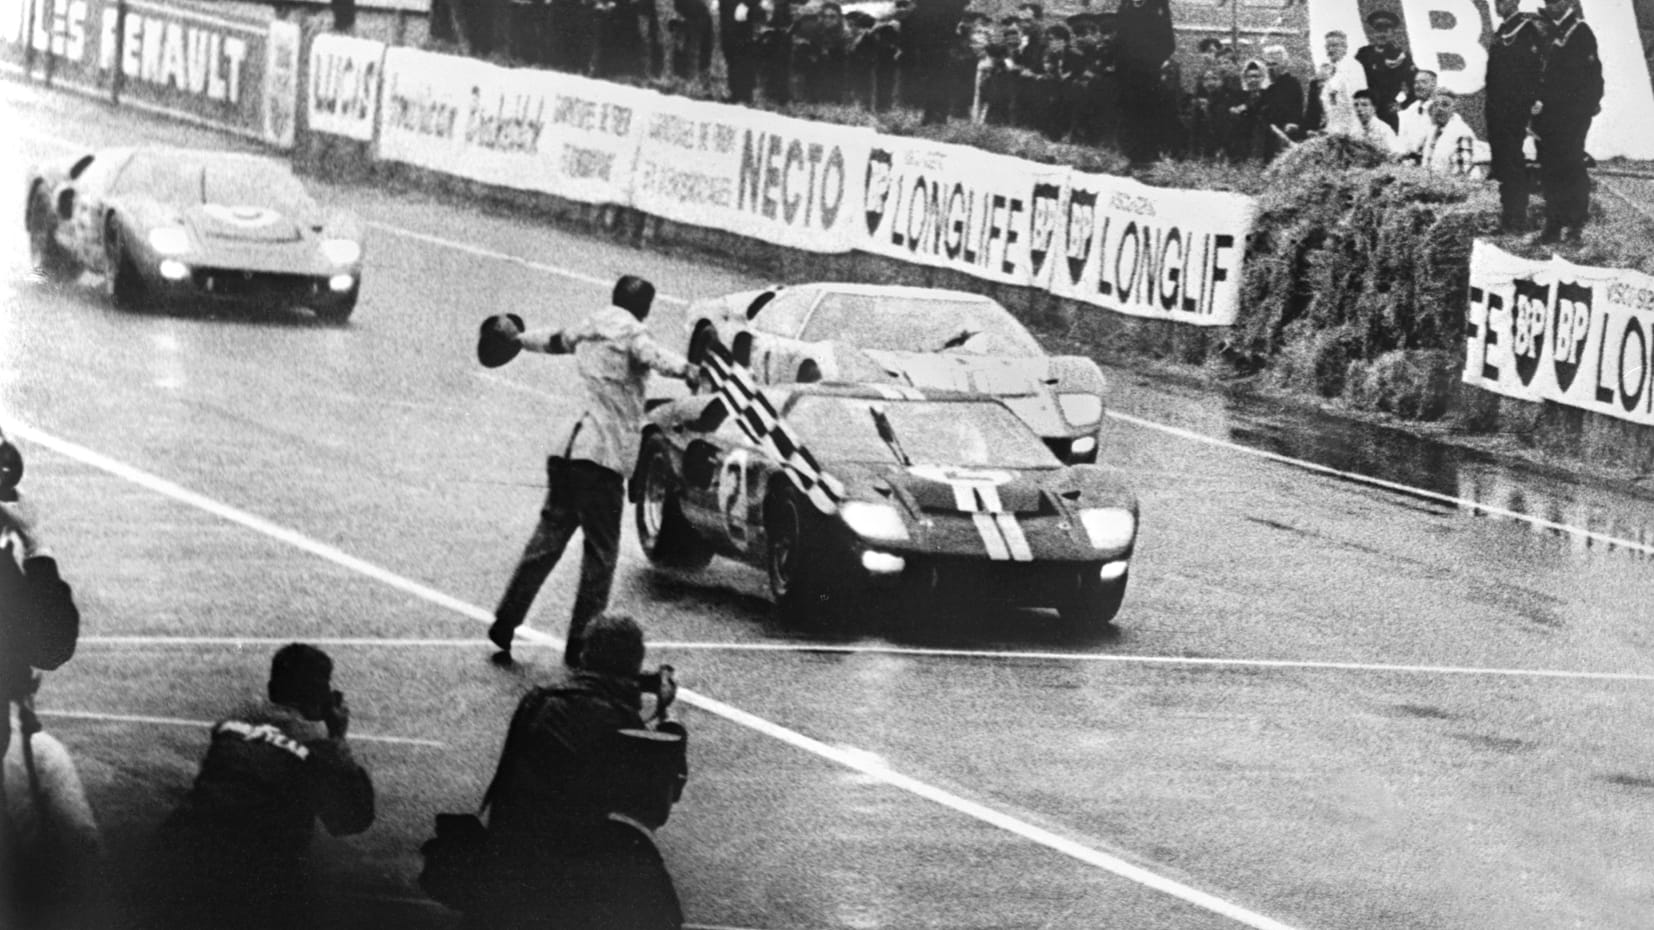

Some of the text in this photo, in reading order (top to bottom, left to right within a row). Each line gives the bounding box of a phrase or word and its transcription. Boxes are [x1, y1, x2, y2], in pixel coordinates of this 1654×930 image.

[99, 6, 247, 103] RENAULT
[738, 127, 846, 231] NECTO
[891, 174, 1024, 275] LONGLIFE
[1098, 216, 1235, 314] LONGLIF
[1595, 312, 1654, 414] LO
